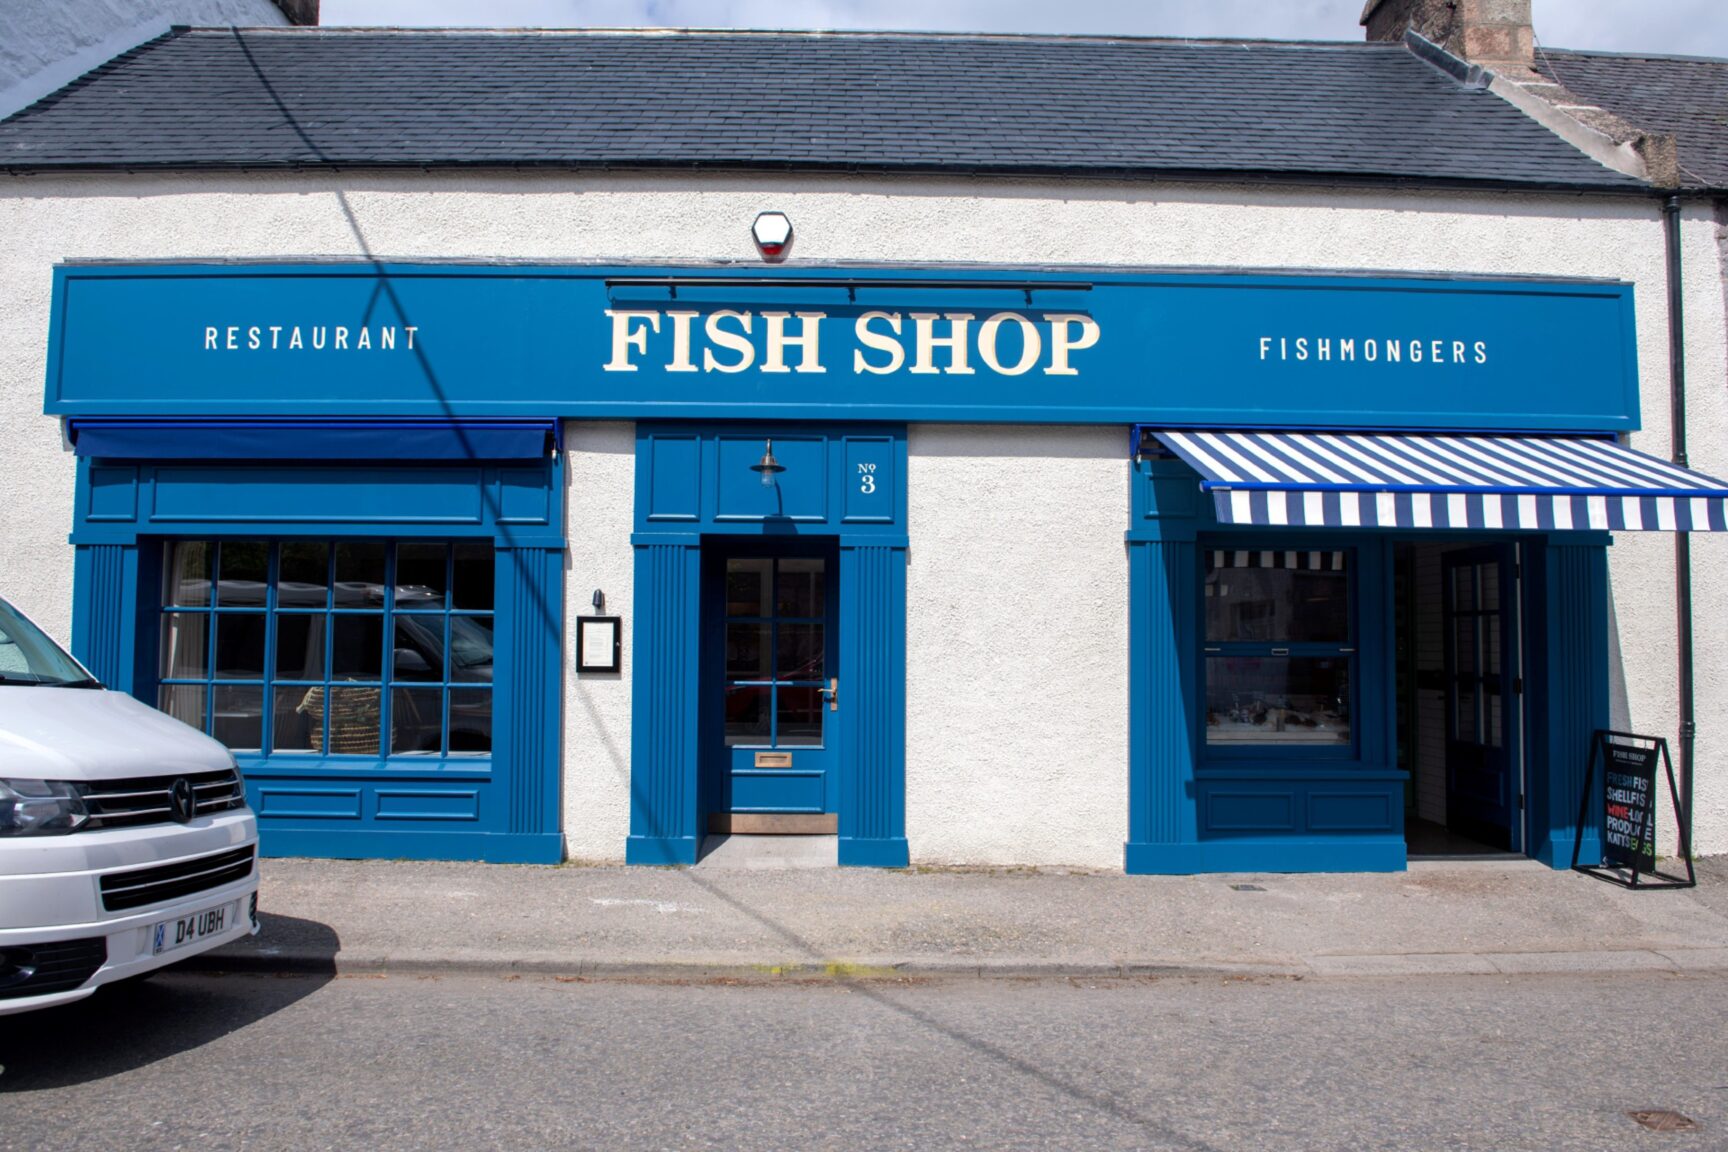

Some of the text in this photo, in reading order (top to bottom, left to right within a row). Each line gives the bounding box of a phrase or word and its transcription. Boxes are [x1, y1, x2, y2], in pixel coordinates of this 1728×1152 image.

[205, 326, 418, 350] RESTAURANT
[603, 308, 1101, 376] FISH SHOP
[1259, 337, 1487, 364] FISHMONGERS
[860, 474, 876, 494] 3
[175, 908, 225, 944] D4 UBH
